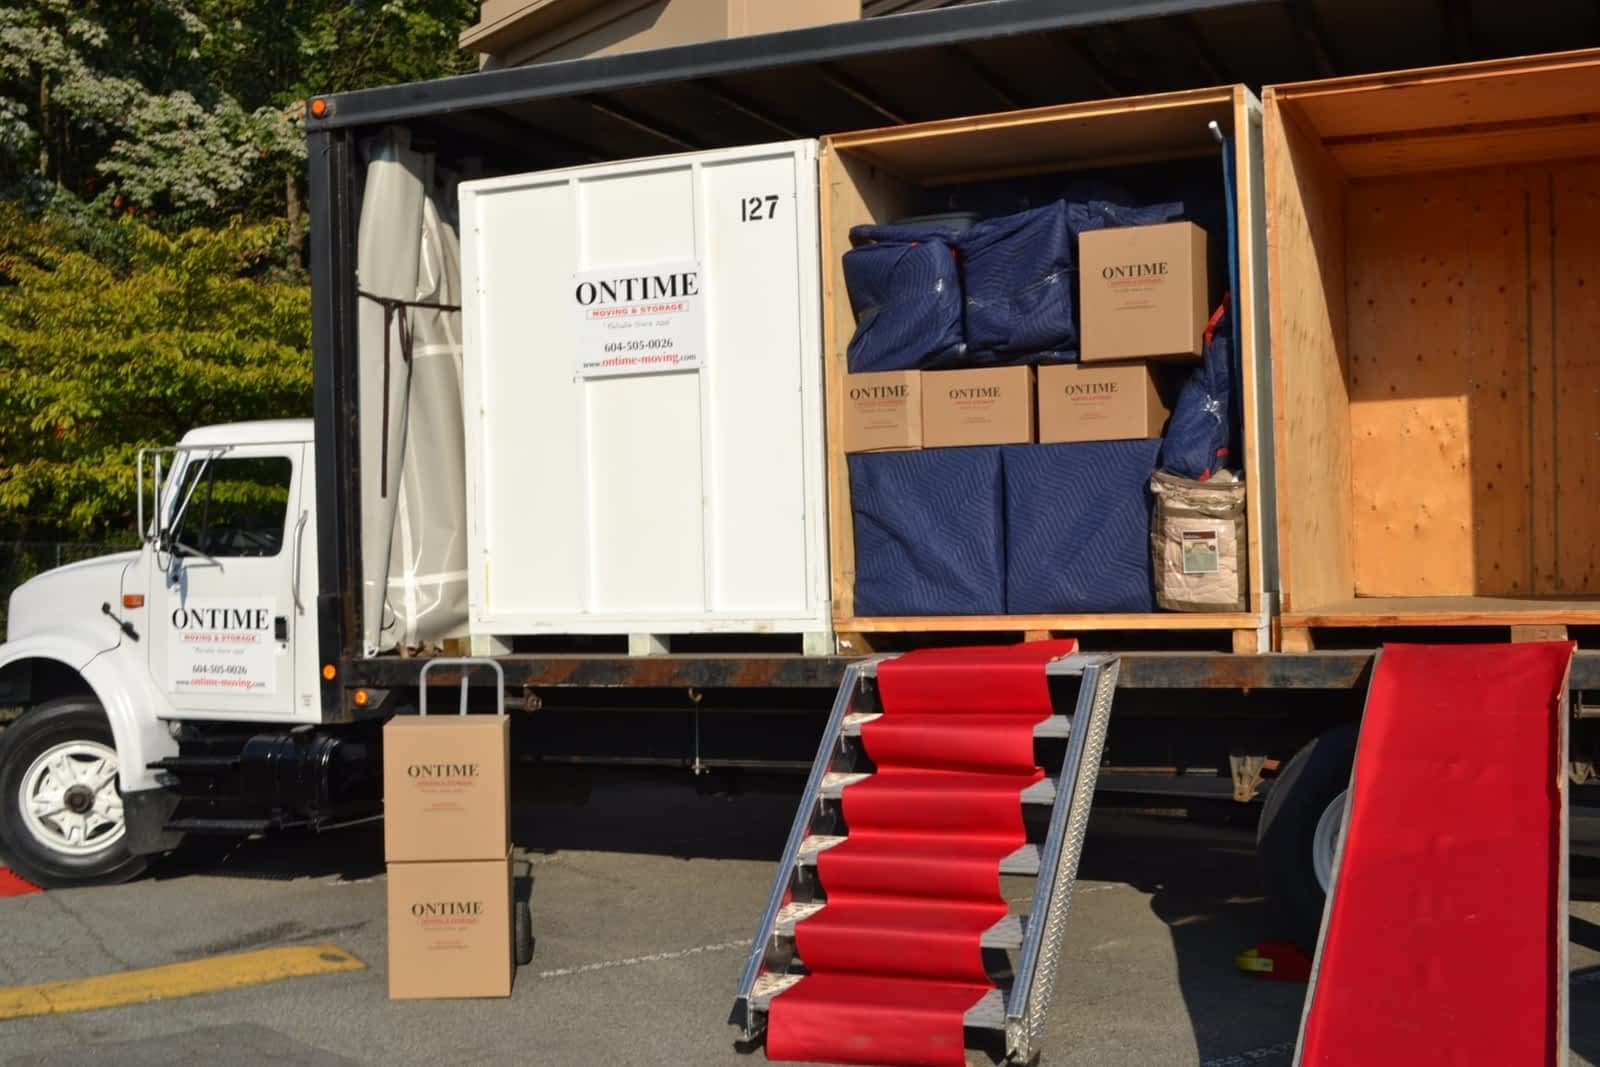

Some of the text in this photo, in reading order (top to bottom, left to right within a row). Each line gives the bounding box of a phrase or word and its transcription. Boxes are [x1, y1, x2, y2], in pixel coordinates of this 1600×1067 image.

[741, 195, 779, 222] 127
[1102, 262, 1168, 280] ONTIME
[575, 272, 700, 306] ONTIME
[592, 306, 629, 318] MOVING
[639, 303, 684, 314] STORAGE
[604, 338, 674, 352] 604-505-0026
[583, 351, 697, 369] www.ontime-moving.com
[850, 384, 910, 400] ONTIME
[949, 386, 1001, 399] ONTIME
[1065, 382, 1119, 395] ONTIME
[172, 608, 270, 630] ONTIME
[183, 633, 212, 642] MOVING
[222, 634, 257, 643] STORAGE
[192, 663, 247, 675] 604-505-0026
[176, 677, 266, 690] www.ontime-moving.com
[407, 763, 480, 778] ONTIME
[411, 901, 484, 917] ONTIME
